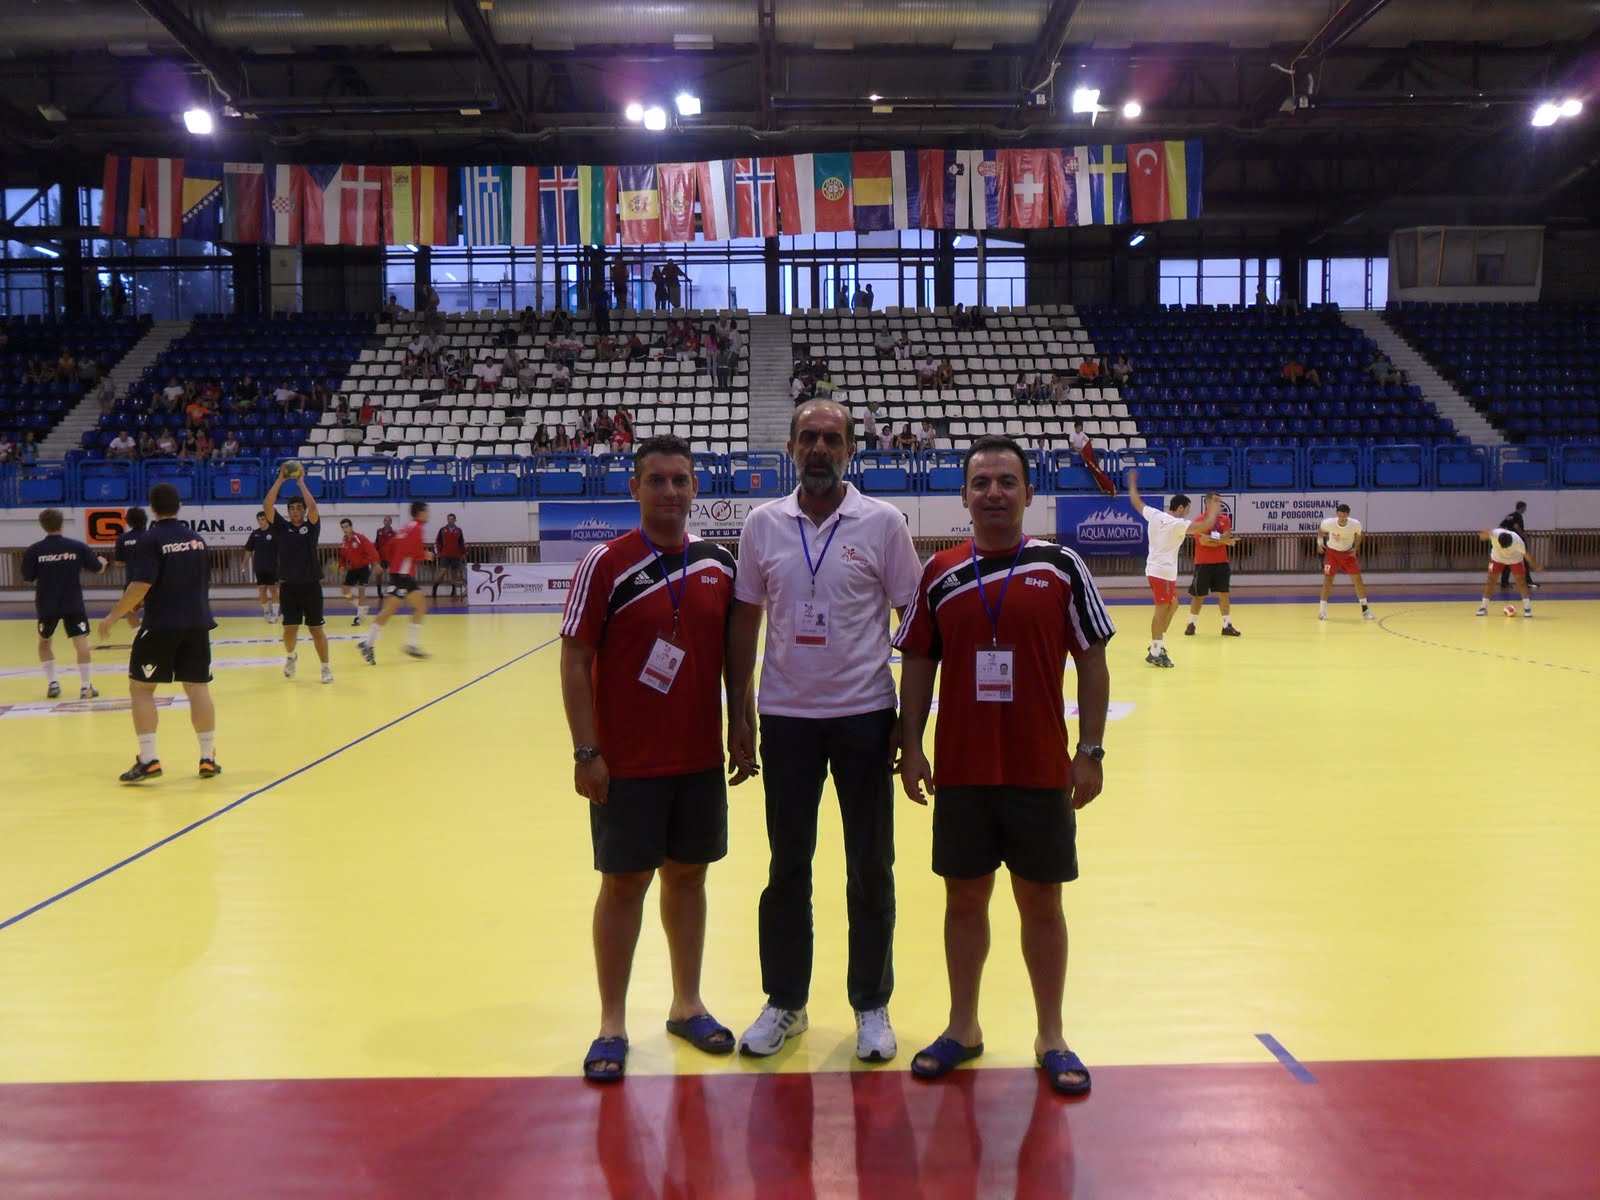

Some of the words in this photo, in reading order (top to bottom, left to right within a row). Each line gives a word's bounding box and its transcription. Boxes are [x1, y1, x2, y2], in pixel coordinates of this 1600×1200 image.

[1267, 511, 1278, 519] AD
[1281, 510, 1324, 519] PODGORICA
[1262, 523, 1289, 532] Filijala
[573, 530, 591, 540] AQUA
[592, 530, 615, 539] MONTA
[1080, 527, 1106, 540] AQUA
[1107, 527, 1140, 539] MONTA
[162, 539, 205, 554] macron
[38, 552, 77, 563] macron
[552, 580, 571, 588] 2010
[633, 578, 655, 586] adidas
[700, 575, 719, 585] EHF
[1024, 577, 1049, 588] EHF
